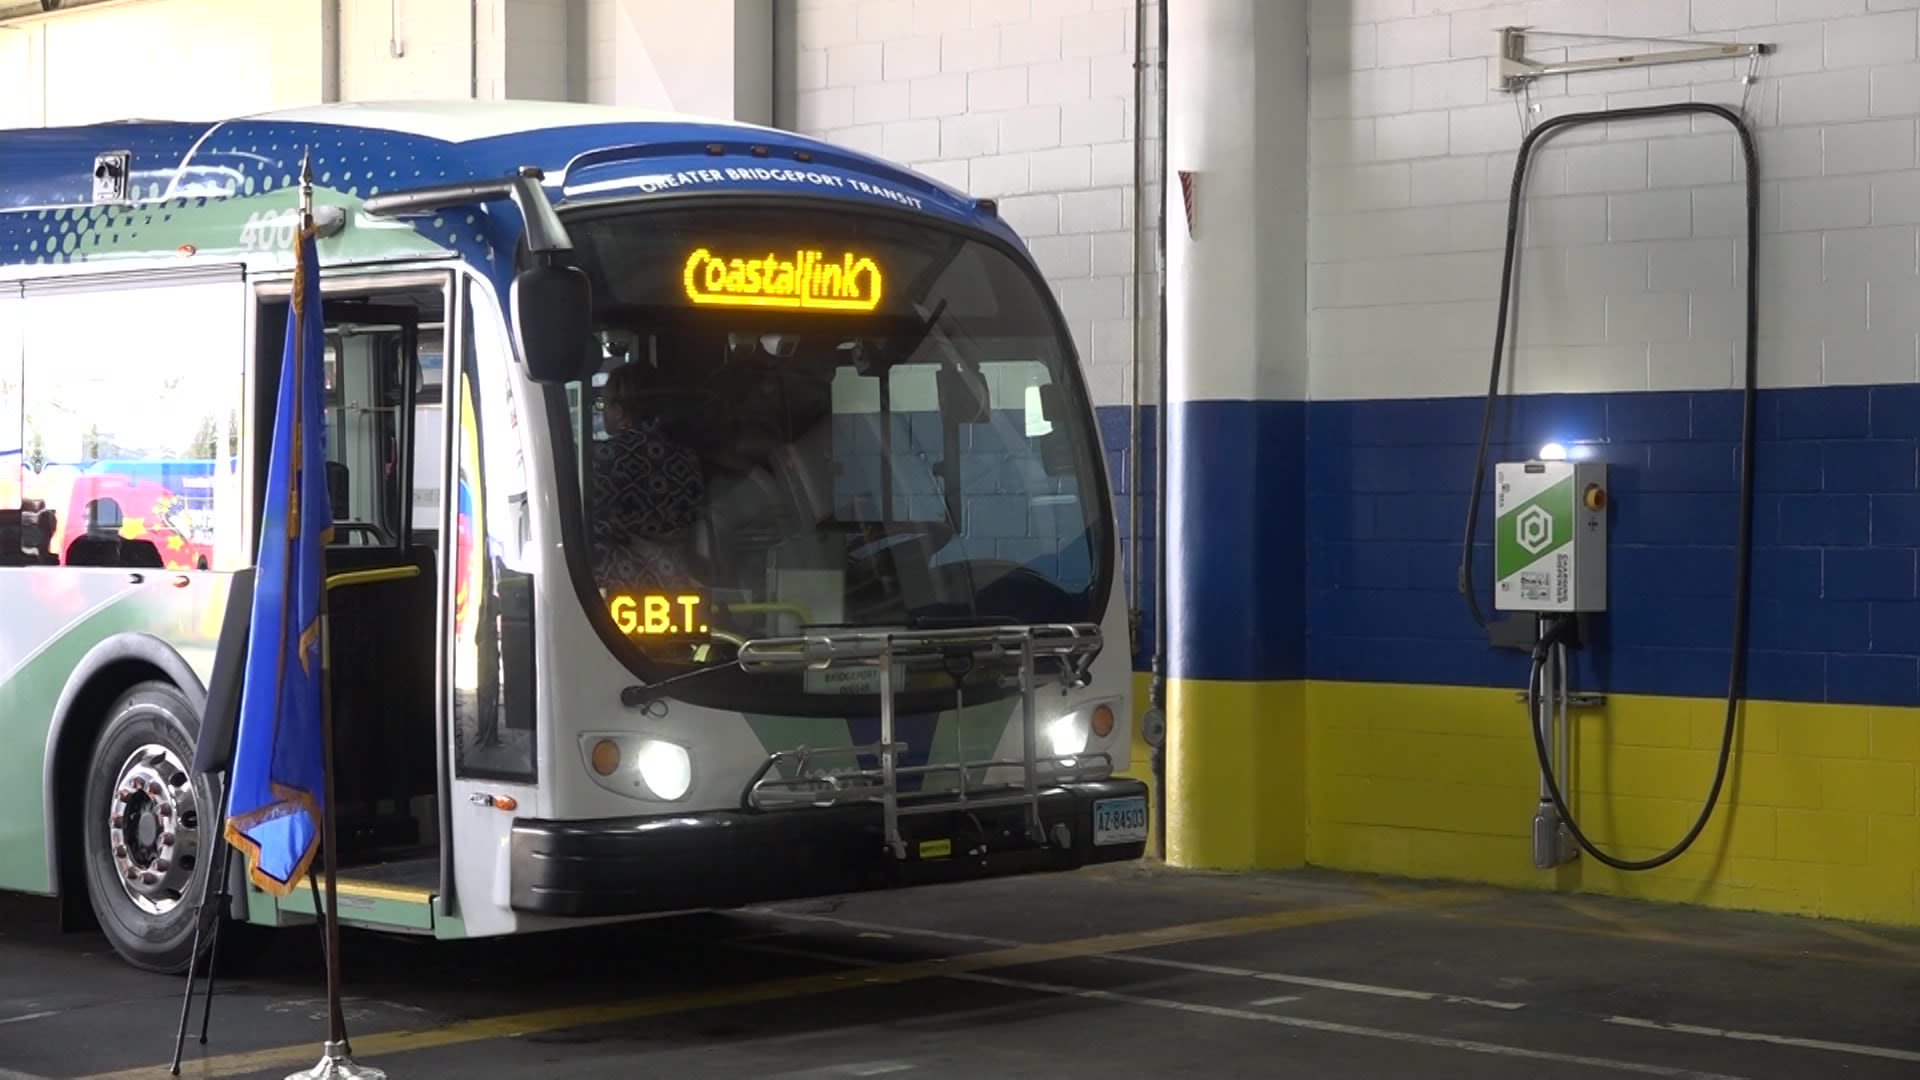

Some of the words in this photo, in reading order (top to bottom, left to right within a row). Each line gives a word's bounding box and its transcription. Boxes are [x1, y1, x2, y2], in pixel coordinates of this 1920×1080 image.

[640, 169, 724, 193] GREATER
[725, 167, 843, 188] BRIDGEPORT
[849, 179, 923, 210] TRANSIT
[240, 207, 300, 251] 400
[611, 595, 708, 634] G.B.T.
